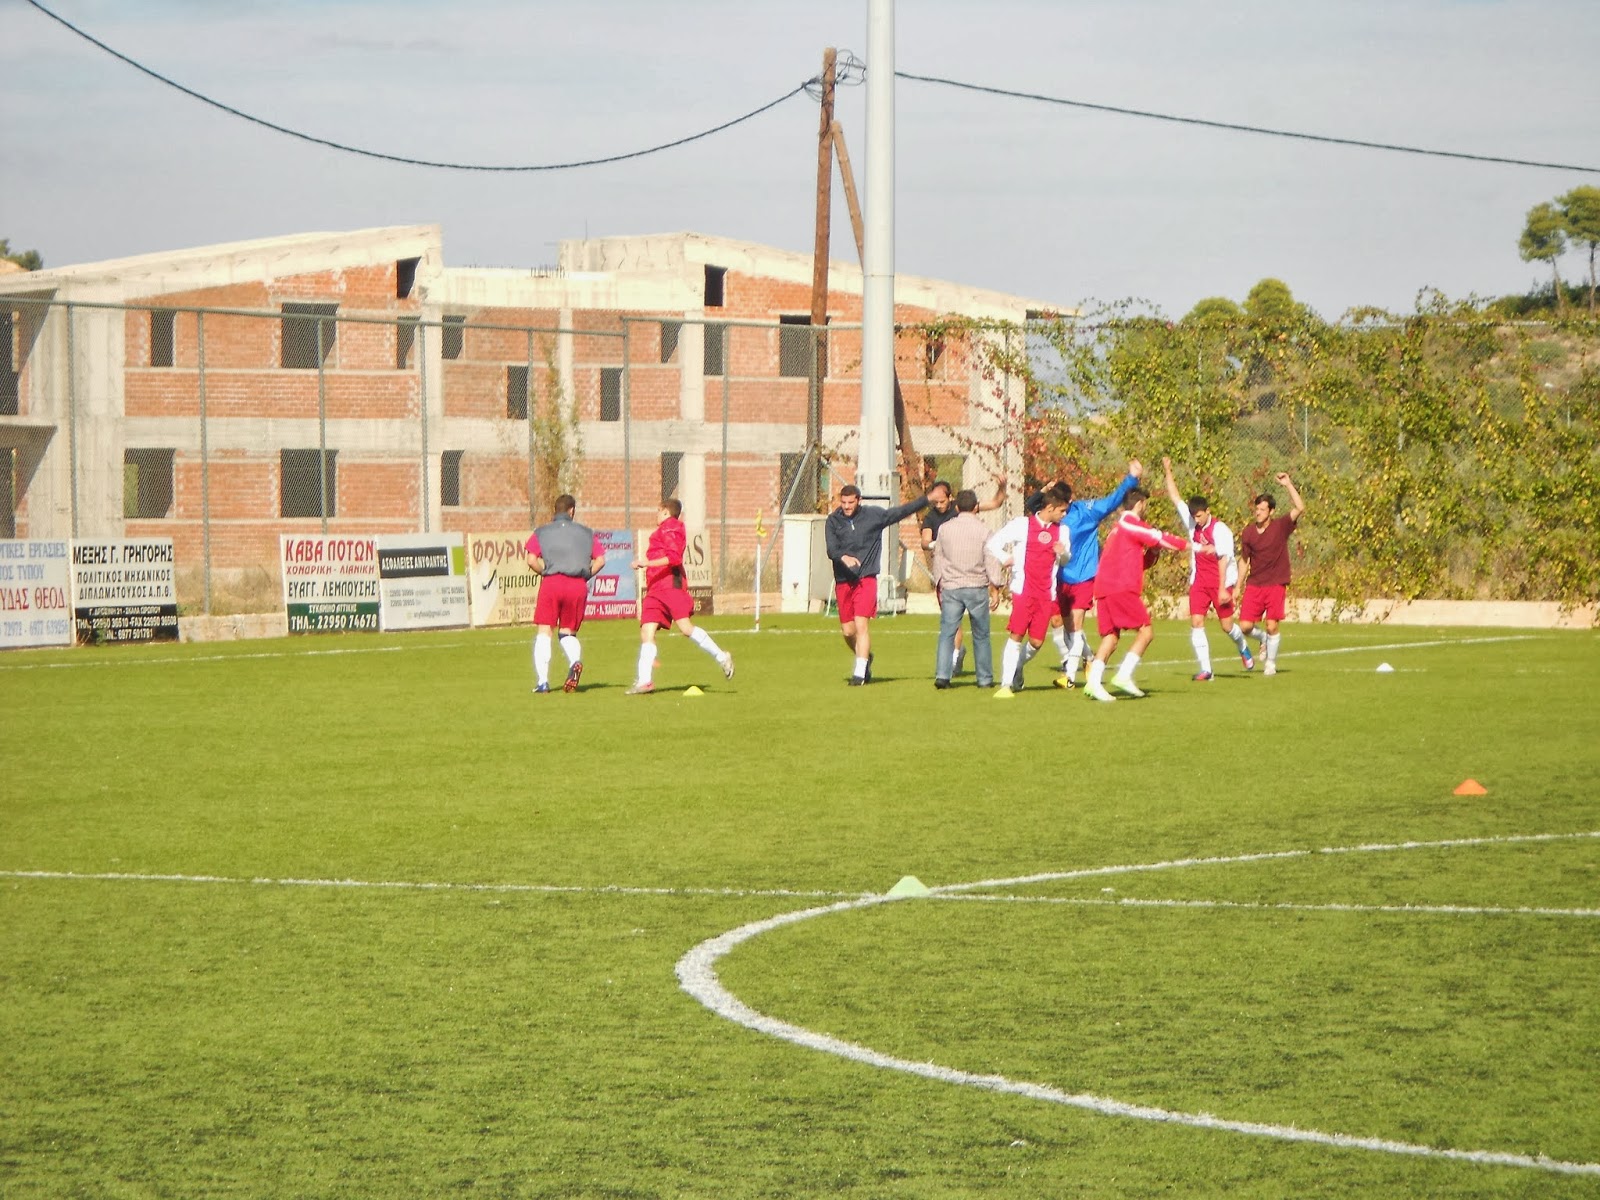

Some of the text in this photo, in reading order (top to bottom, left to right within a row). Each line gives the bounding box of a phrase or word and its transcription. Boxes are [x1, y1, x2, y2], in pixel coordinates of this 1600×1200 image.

[73, 544, 173, 564] ΜΕΞΗΣ Γ. ΓΡΗΓΟΡΗΣ
[285, 539, 374, 563] ΚΑΒΑ ΠΟΤΩΝ
[473, 539, 526, 565] ΦΟΥΡΝ
[684, 534, 704, 566] AS
[17, 564, 45, 580] ΤΥΠΟΥ
[77, 569, 170, 584] ΠΟΛΙΤΙΚΟΣ ΜΗΧΑΝΙΚΟΣ
[286, 565, 332, 575] ΧΟΝΔΡΙΚΗ
[340, 565, 375, 575] ΛΙΑΝΙΚΗ
[687, 570, 710, 581] URANT
[35, 587, 67, 609] ΘΕΟΔ.
[79, 586, 146, 600] ΔΙΠΛΩΜΑΤΟΥΧΟΣ
[288, 580, 376, 599] ΕΥΑΓΓ. ΛΕΜΠΟΥΣΗΣ
[291, 613, 377, 631] ΤΗΛ.: 22950 74678
